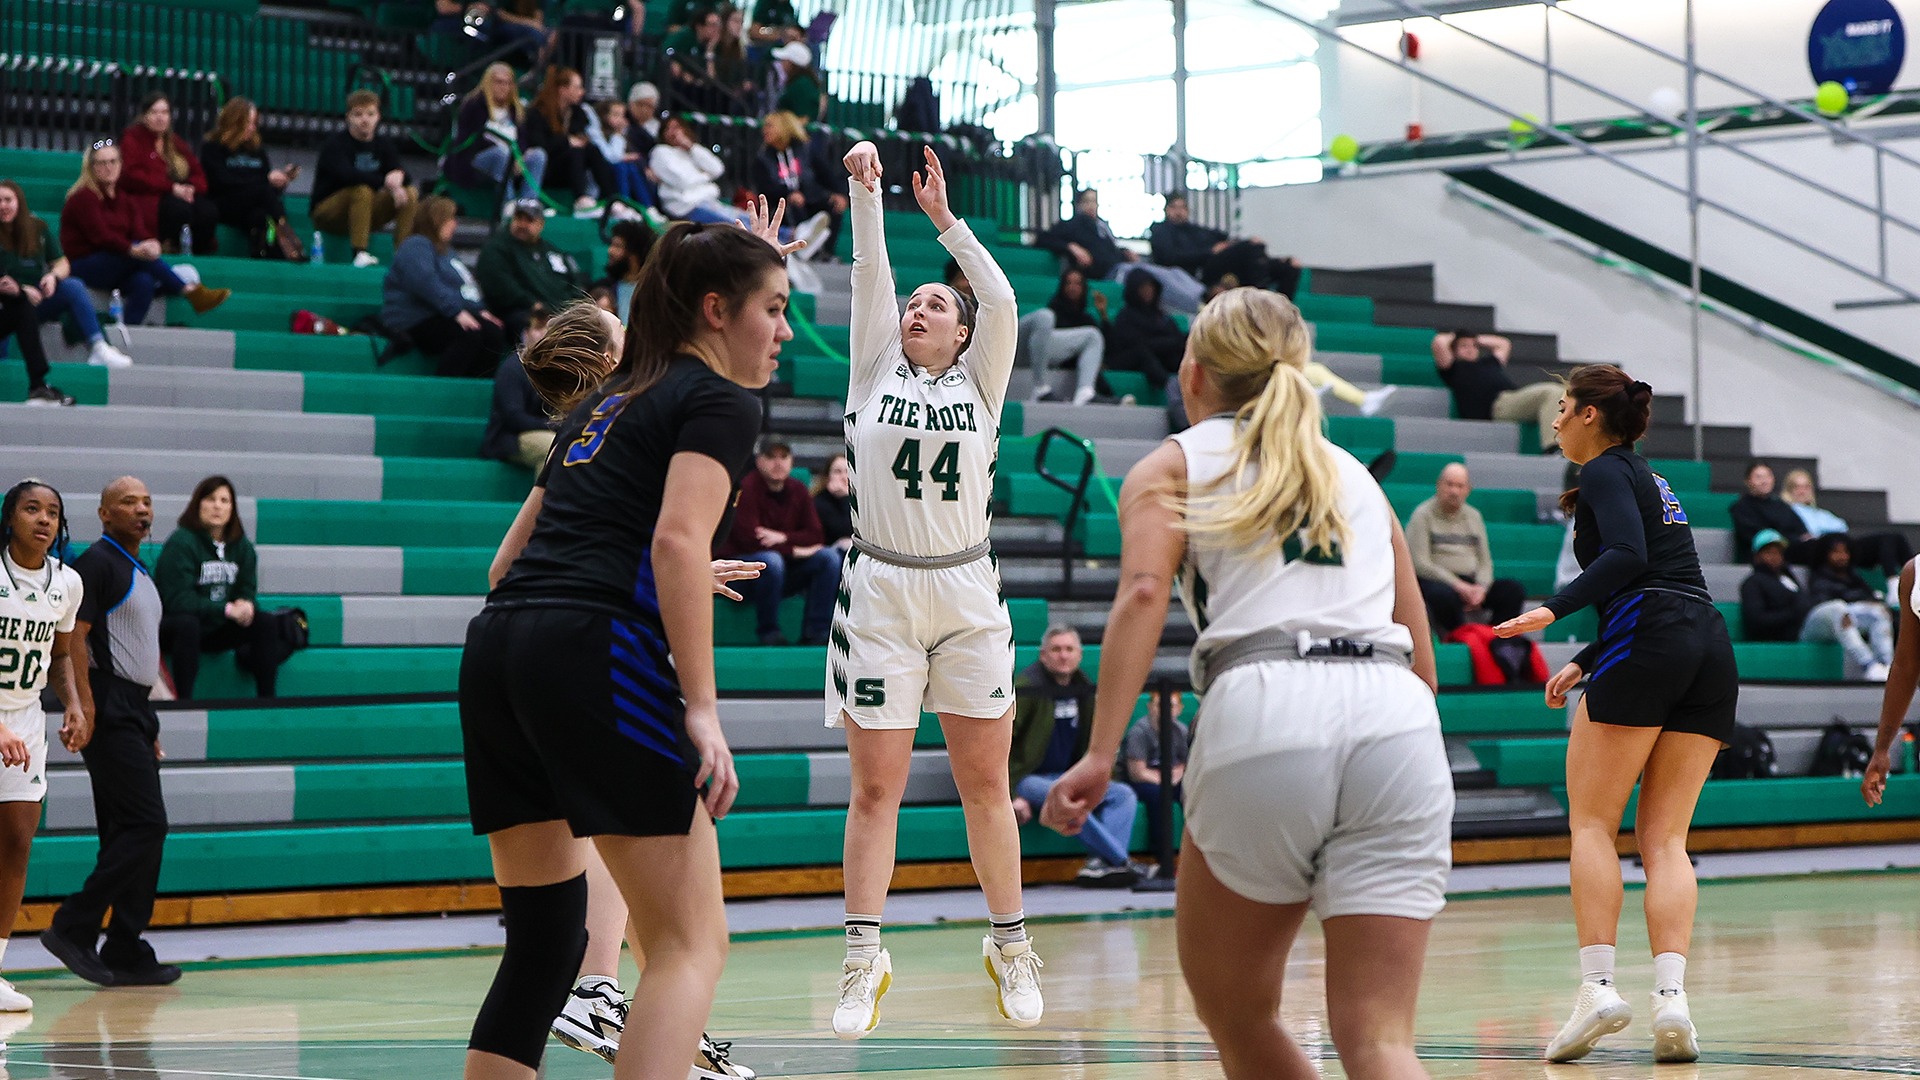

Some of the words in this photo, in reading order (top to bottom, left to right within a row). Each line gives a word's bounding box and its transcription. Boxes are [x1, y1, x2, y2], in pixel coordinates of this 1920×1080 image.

[563, 391, 630, 467] 3
[877, 394, 920, 429] THE
[924, 402, 977, 433] ROCK
[891, 437, 961, 502] 44
[1651, 472, 1689, 525] 15
[0, 616, 21, 641] HE
[23, 619, 59, 643] ROC
[0, 647, 42, 690] 20
[854, 677, 887, 708] S
